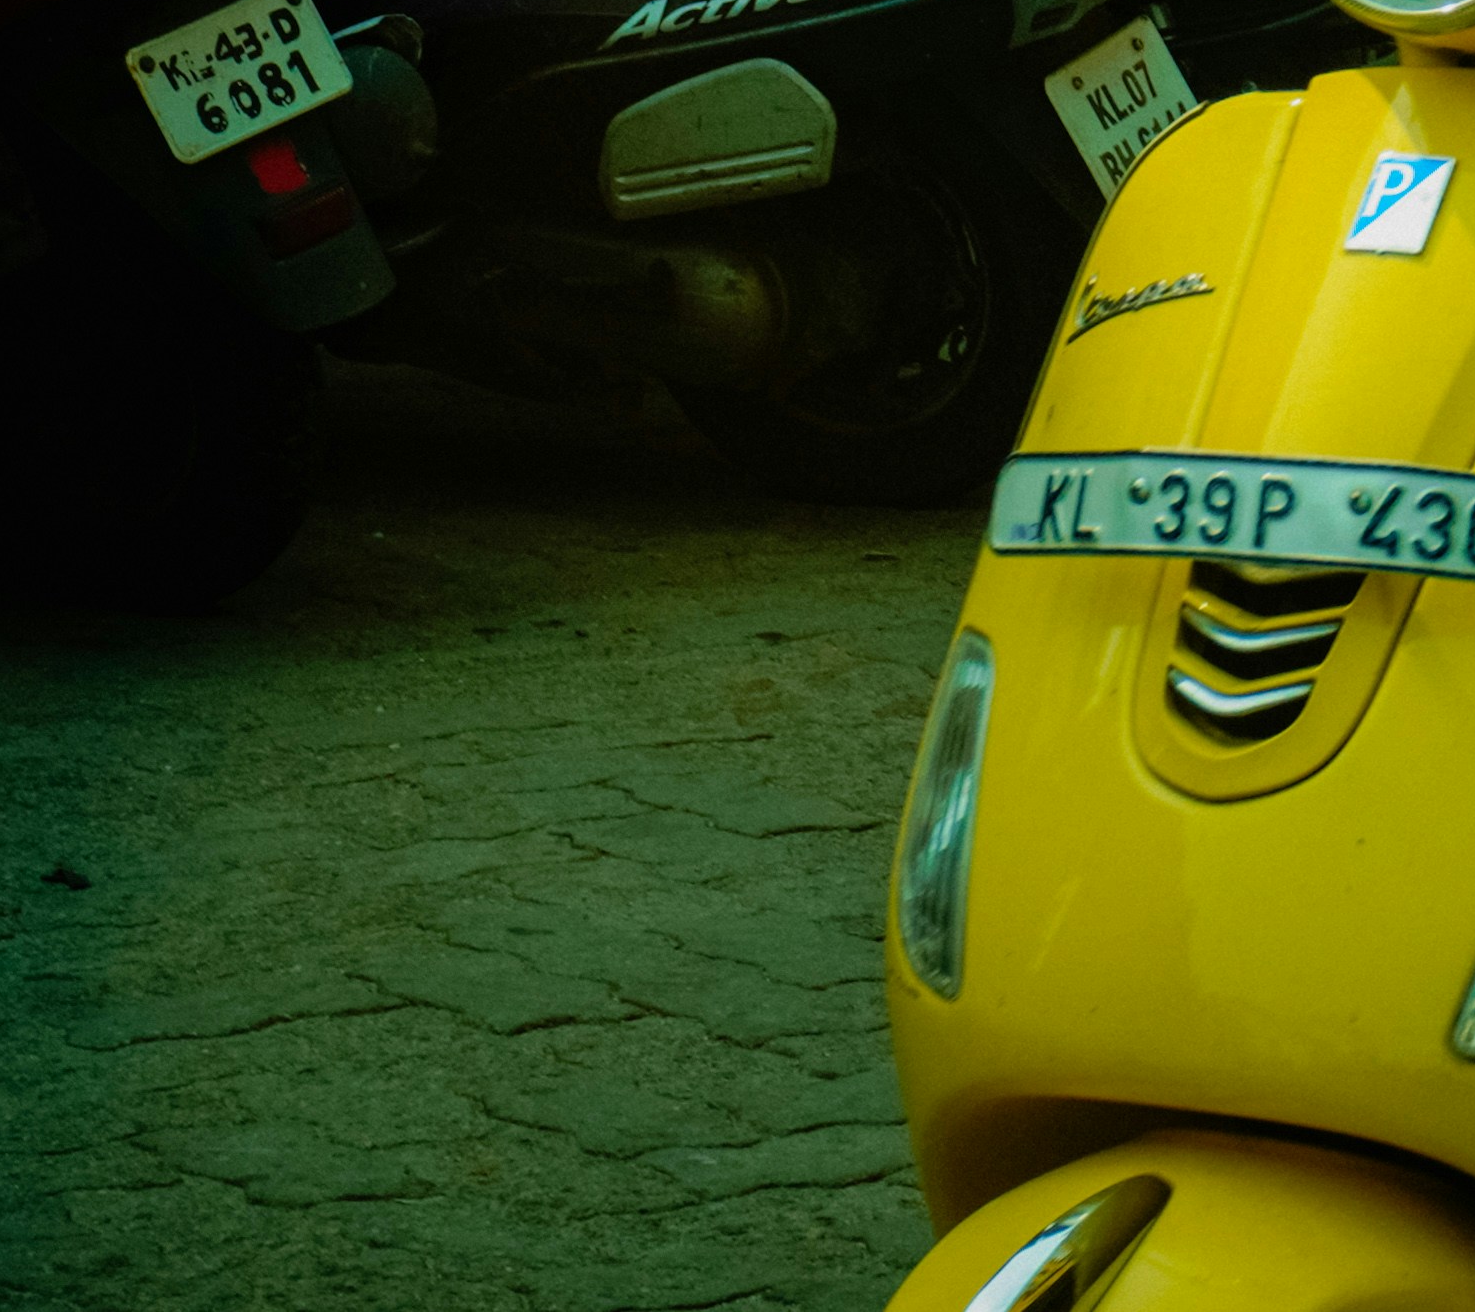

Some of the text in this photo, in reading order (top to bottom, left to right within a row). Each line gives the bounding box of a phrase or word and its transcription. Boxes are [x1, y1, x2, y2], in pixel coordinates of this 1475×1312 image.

[196, 49, 321, 134] 6081
[1361, 161, 1416, 219] P
[1036, 468, 1097, 544] KL
